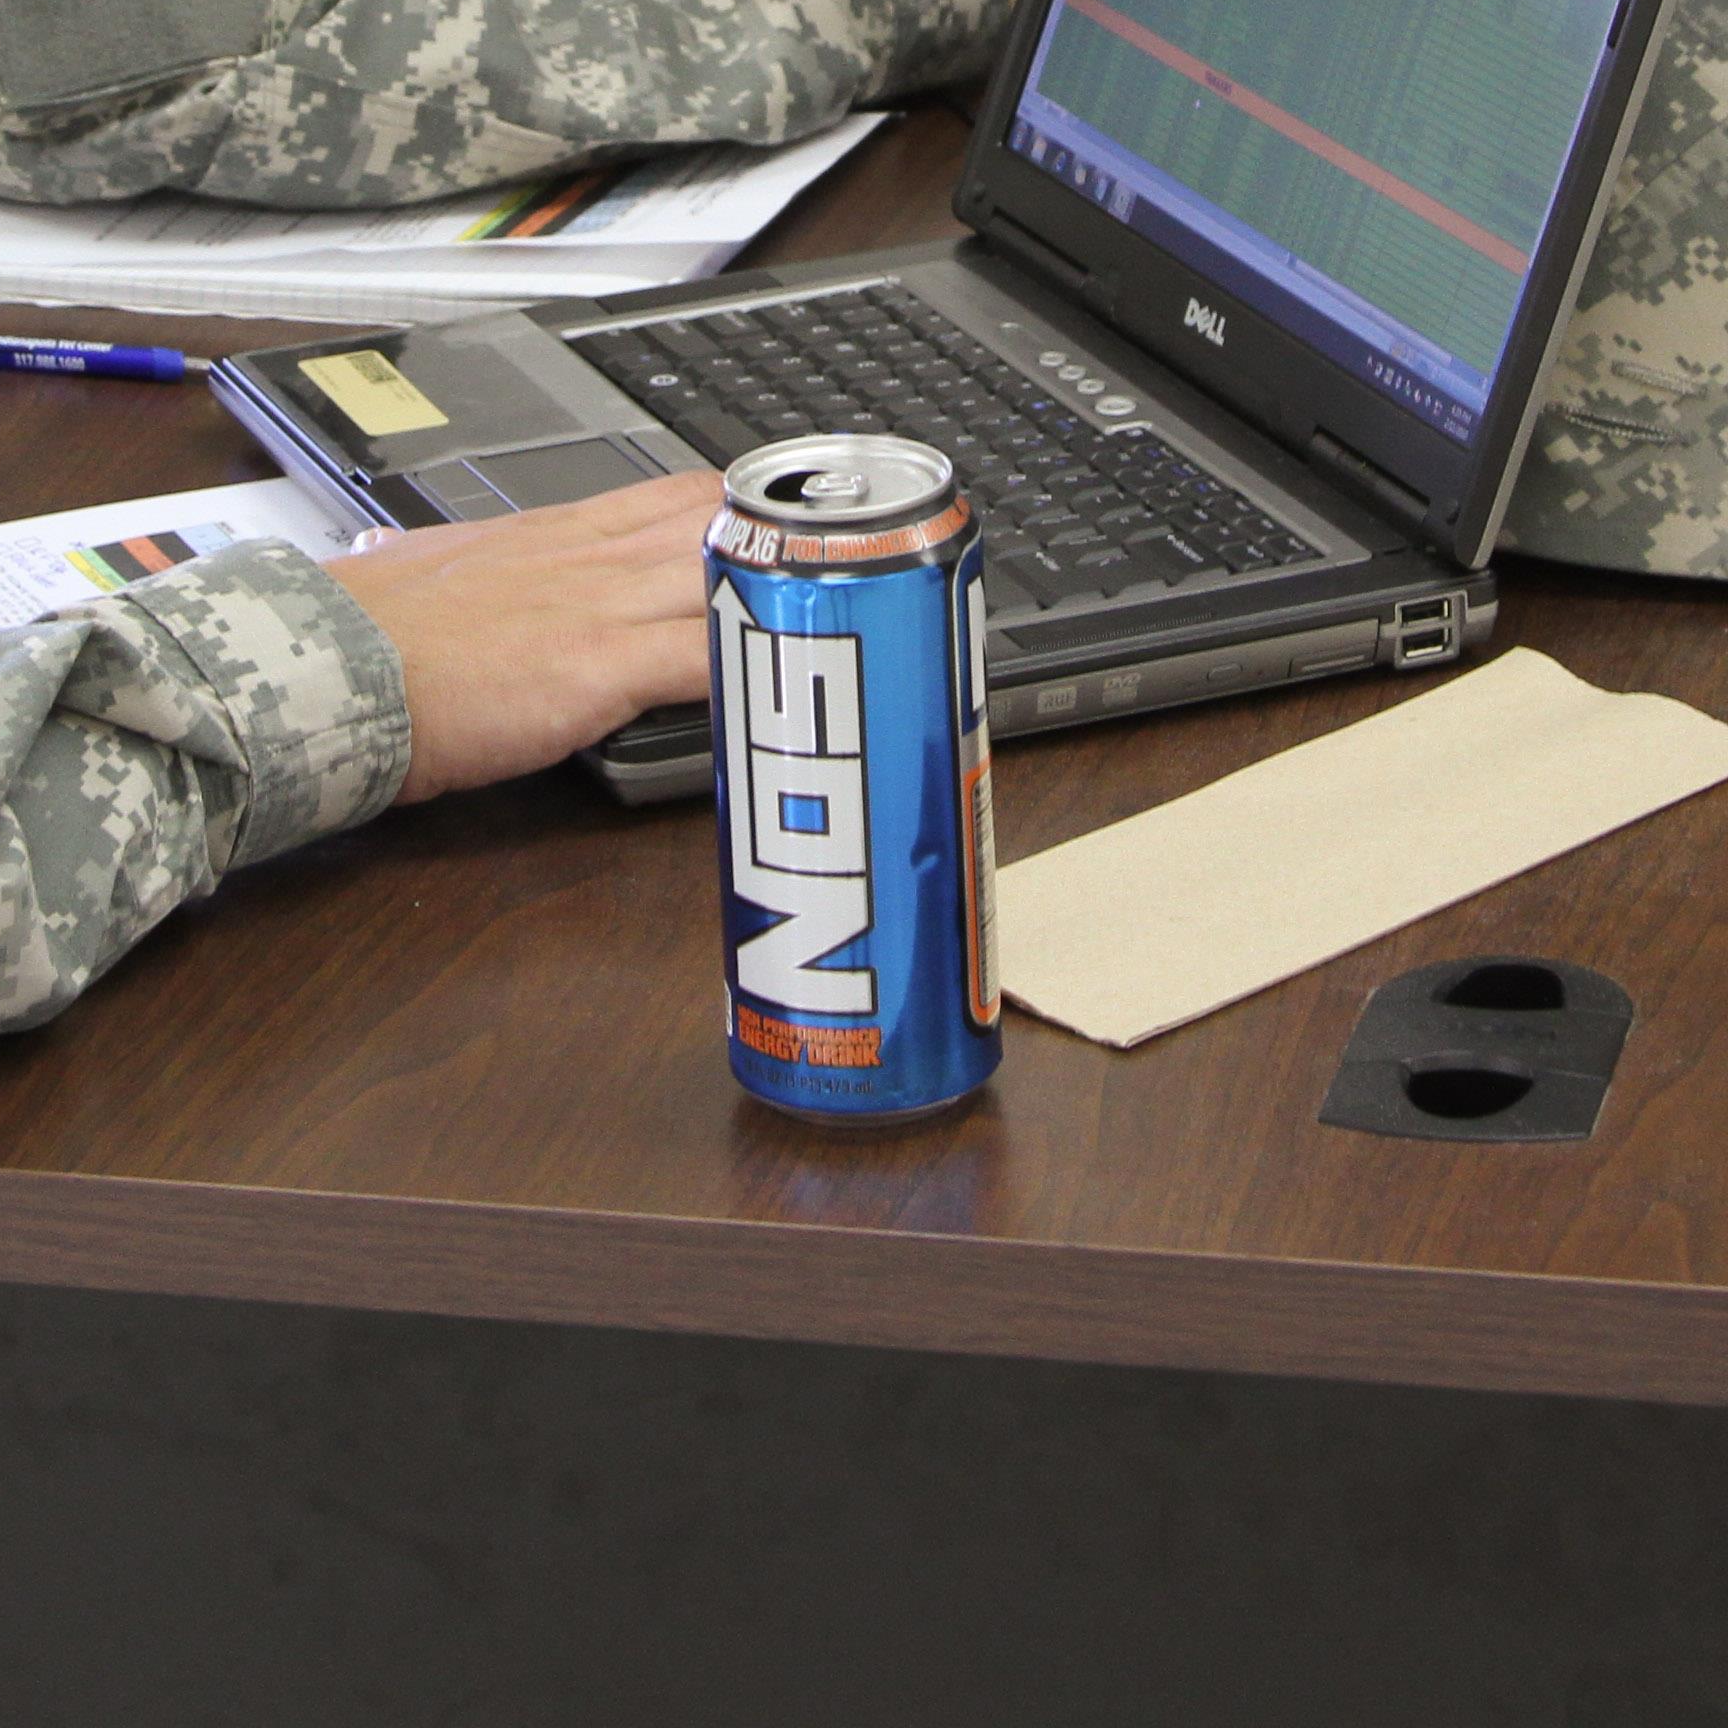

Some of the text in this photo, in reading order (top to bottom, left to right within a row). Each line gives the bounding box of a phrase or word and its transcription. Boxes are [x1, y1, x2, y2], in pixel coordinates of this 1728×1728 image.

[1184, 297, 1225, 346] DELL
[736, 626, 875, 1012] NOS
[739, 1024, 881, 1066] ENERGY DRINK
